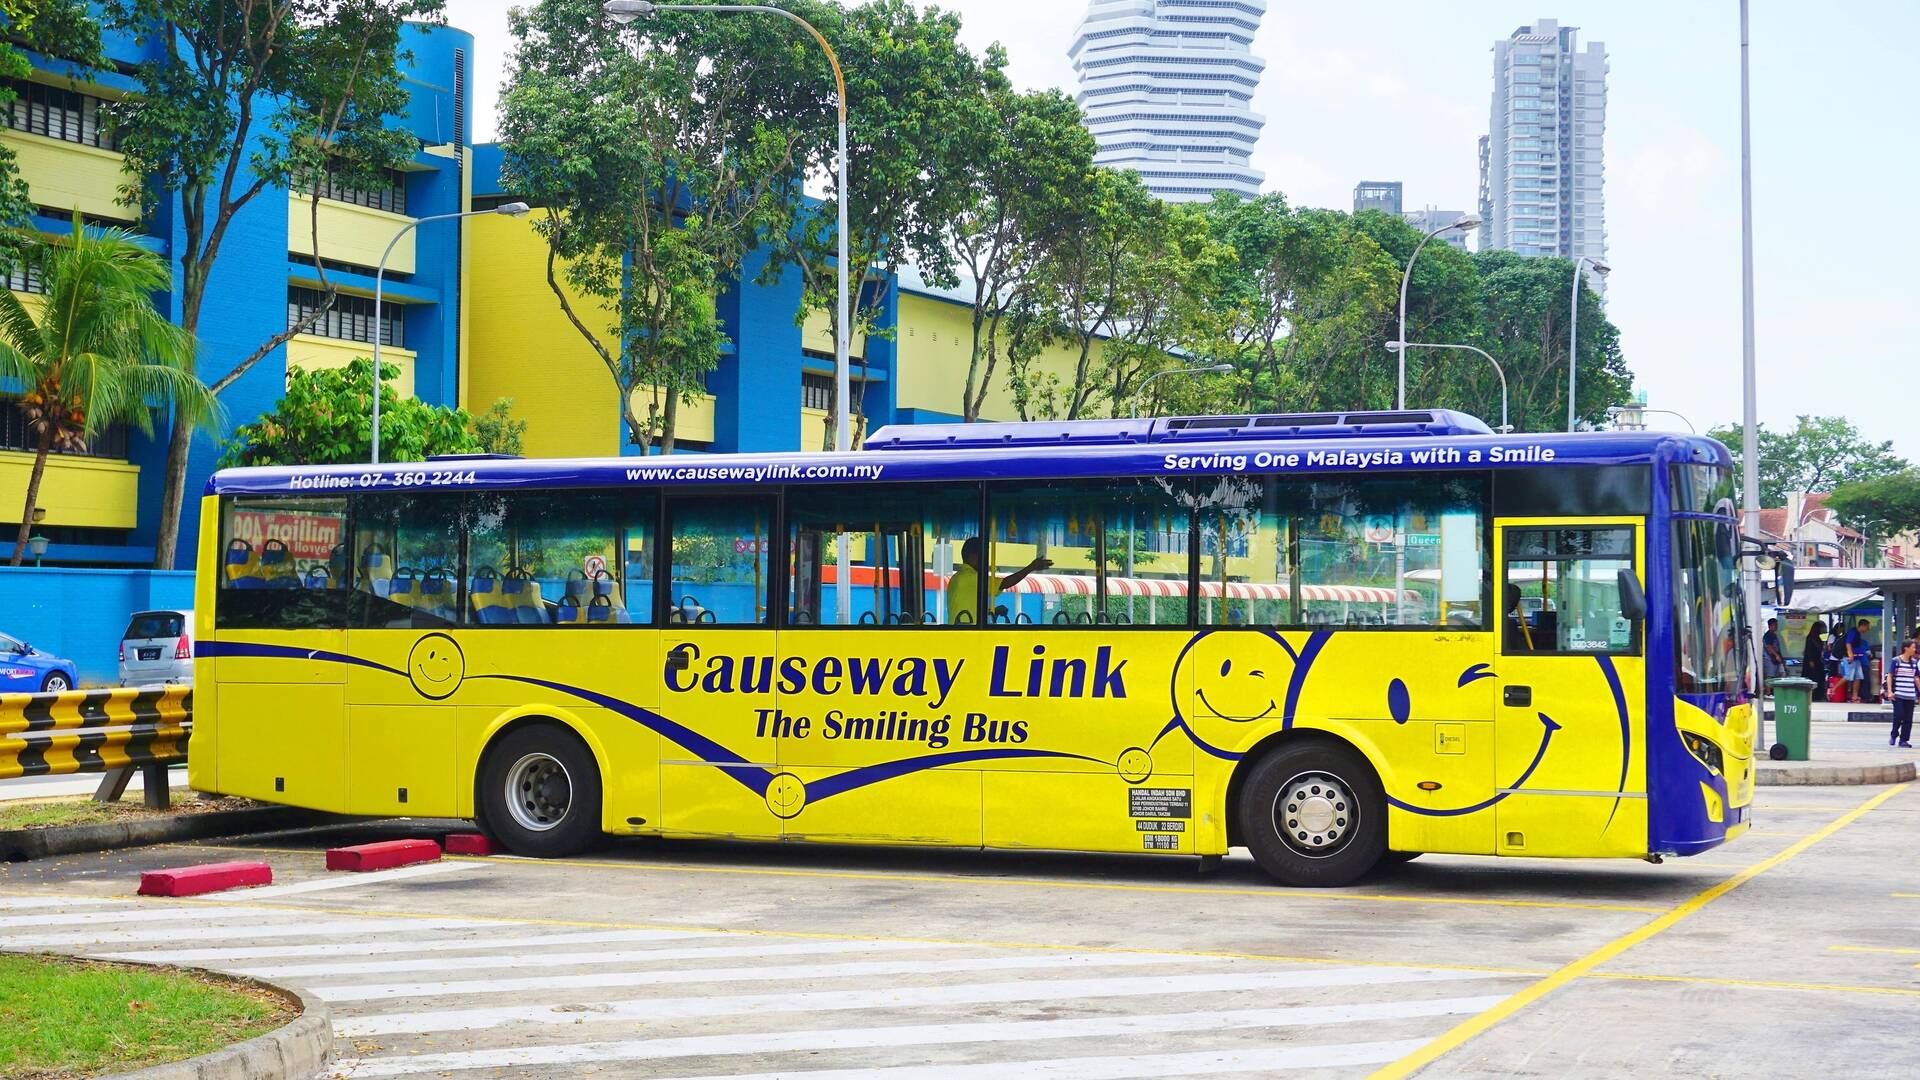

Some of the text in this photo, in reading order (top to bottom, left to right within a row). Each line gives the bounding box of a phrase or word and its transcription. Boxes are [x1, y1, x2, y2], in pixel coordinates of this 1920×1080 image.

[1164, 445, 1555, 471] Serving One Malaysia with a Smile
[290, 470, 476, 490] Hotline: 07- 360 2244
[625, 463, 884, 482] www.causewaylink.com.my
[664, 642, 1129, 710] Causeway Link
[753, 708, 1029, 748] The Smiling Bus
